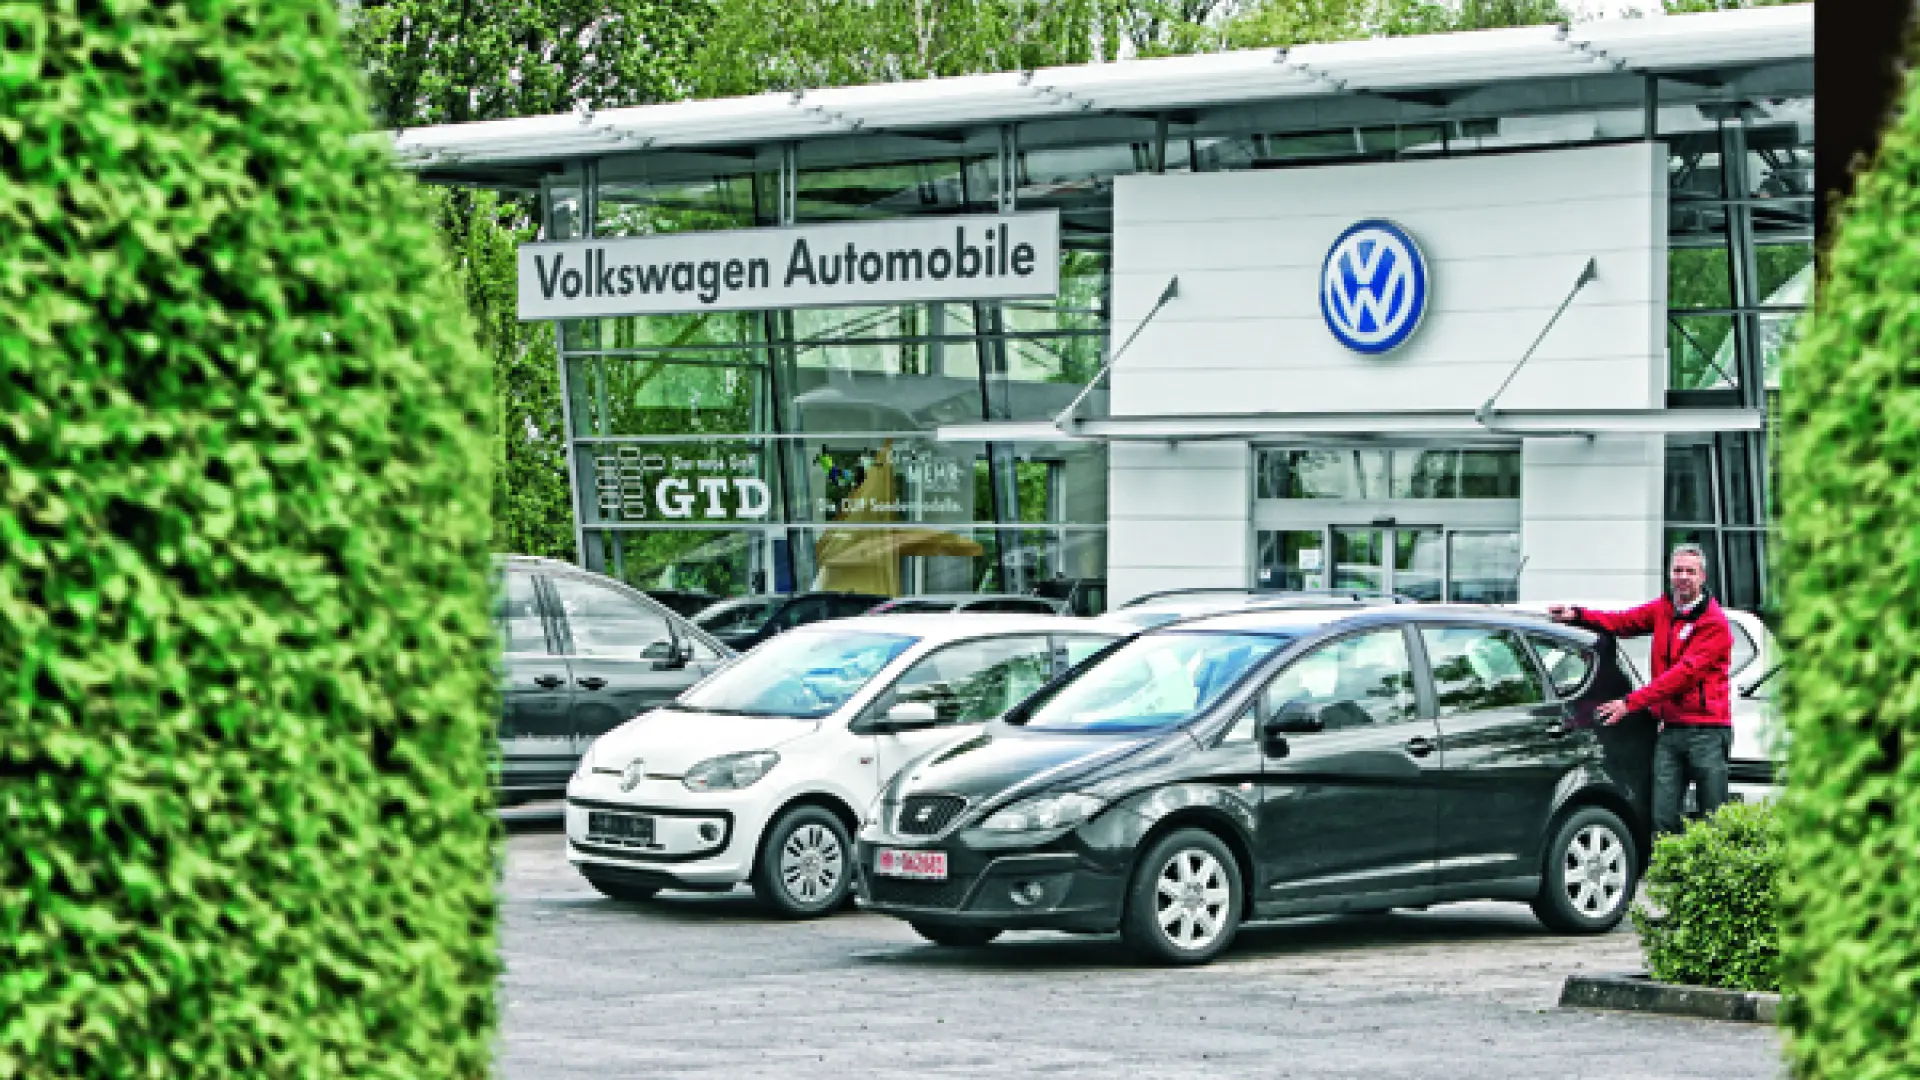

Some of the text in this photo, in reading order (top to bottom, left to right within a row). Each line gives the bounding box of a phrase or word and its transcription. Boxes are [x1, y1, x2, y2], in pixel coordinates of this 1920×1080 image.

[535, 224, 1036, 303] Volkswagen Automobile
[656, 476, 771, 518] GTD
